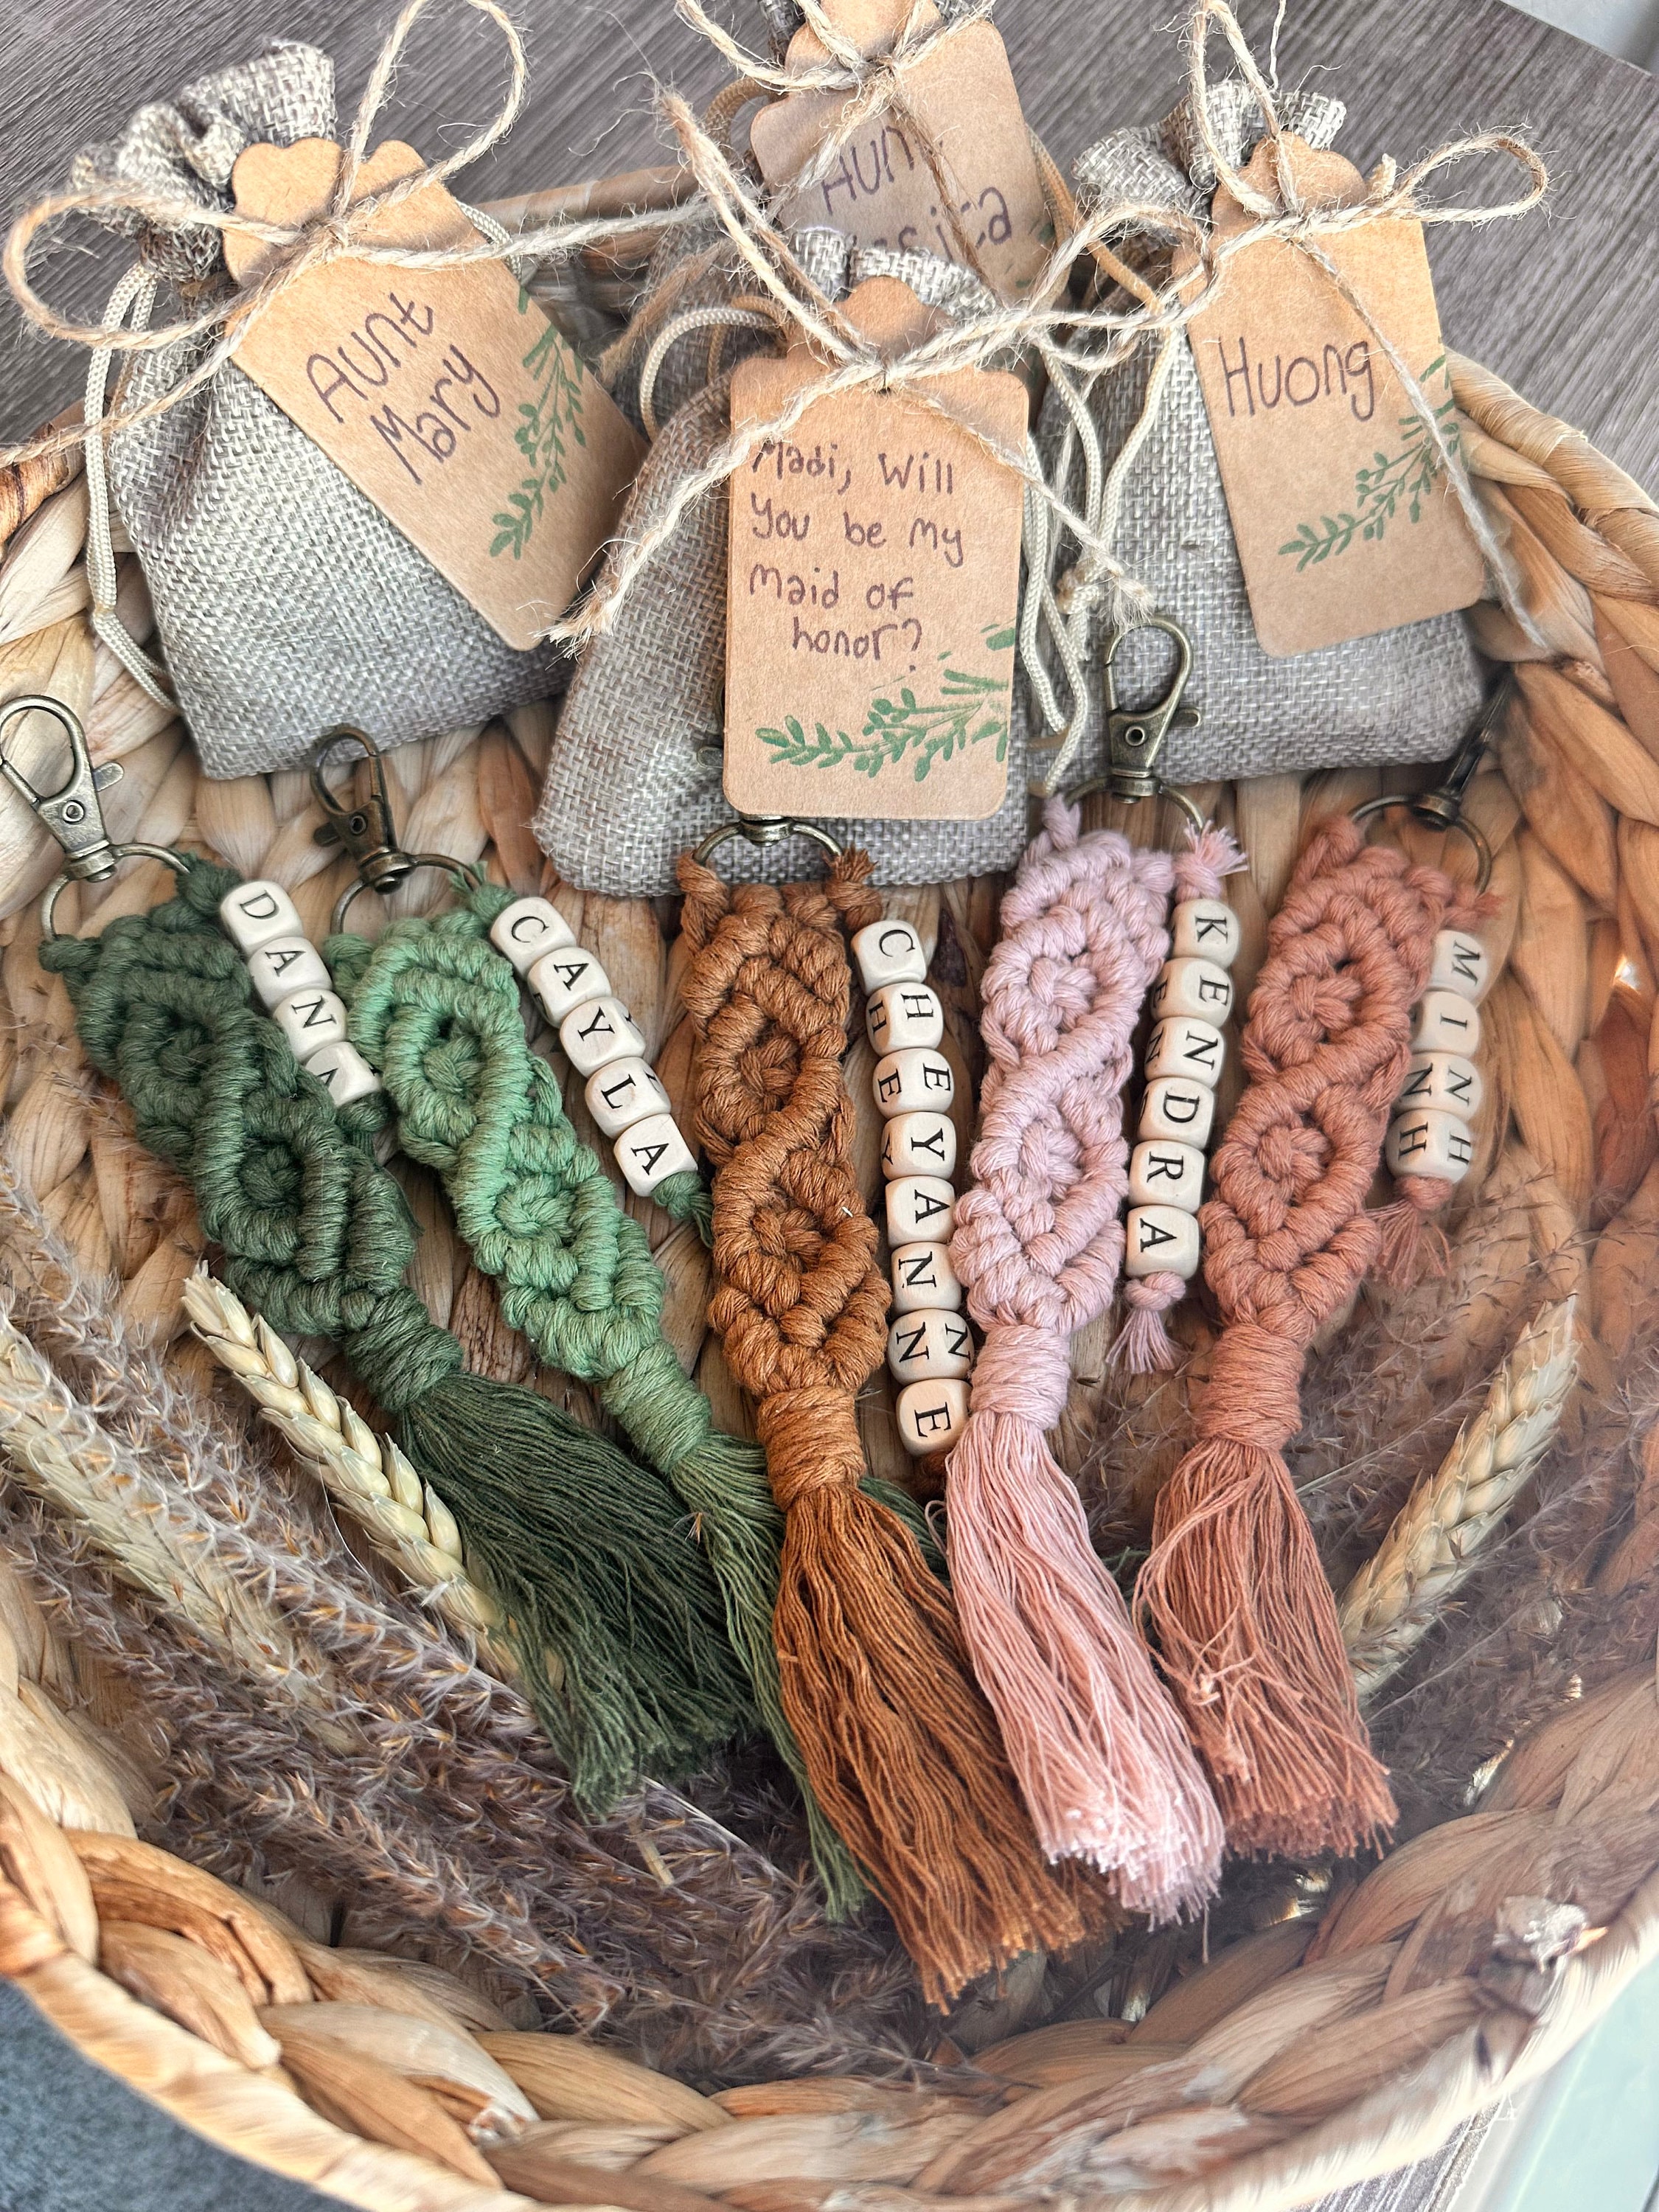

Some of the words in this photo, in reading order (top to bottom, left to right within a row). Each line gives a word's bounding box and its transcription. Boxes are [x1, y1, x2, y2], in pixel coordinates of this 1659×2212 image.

[821, 125, 944, 216] Aun
[306, 292, 434, 424] Aunt
[1218, 336, 1375, 422] Huong
[369, 344, 501, 485] Mary
[751, 439, 852, 495] Madi,
[843, 511, 886, 549] be
[792, 616, 922, 672] honor?
[866, 577, 914, 611] of
[510, 915, 670, 1176] CAYLA
[1139, 914, 1233, 1253] KENDRA
[1399, 940, 1481, 1166] MINH
[880, 929, 952, 1438] CHEYANNE
